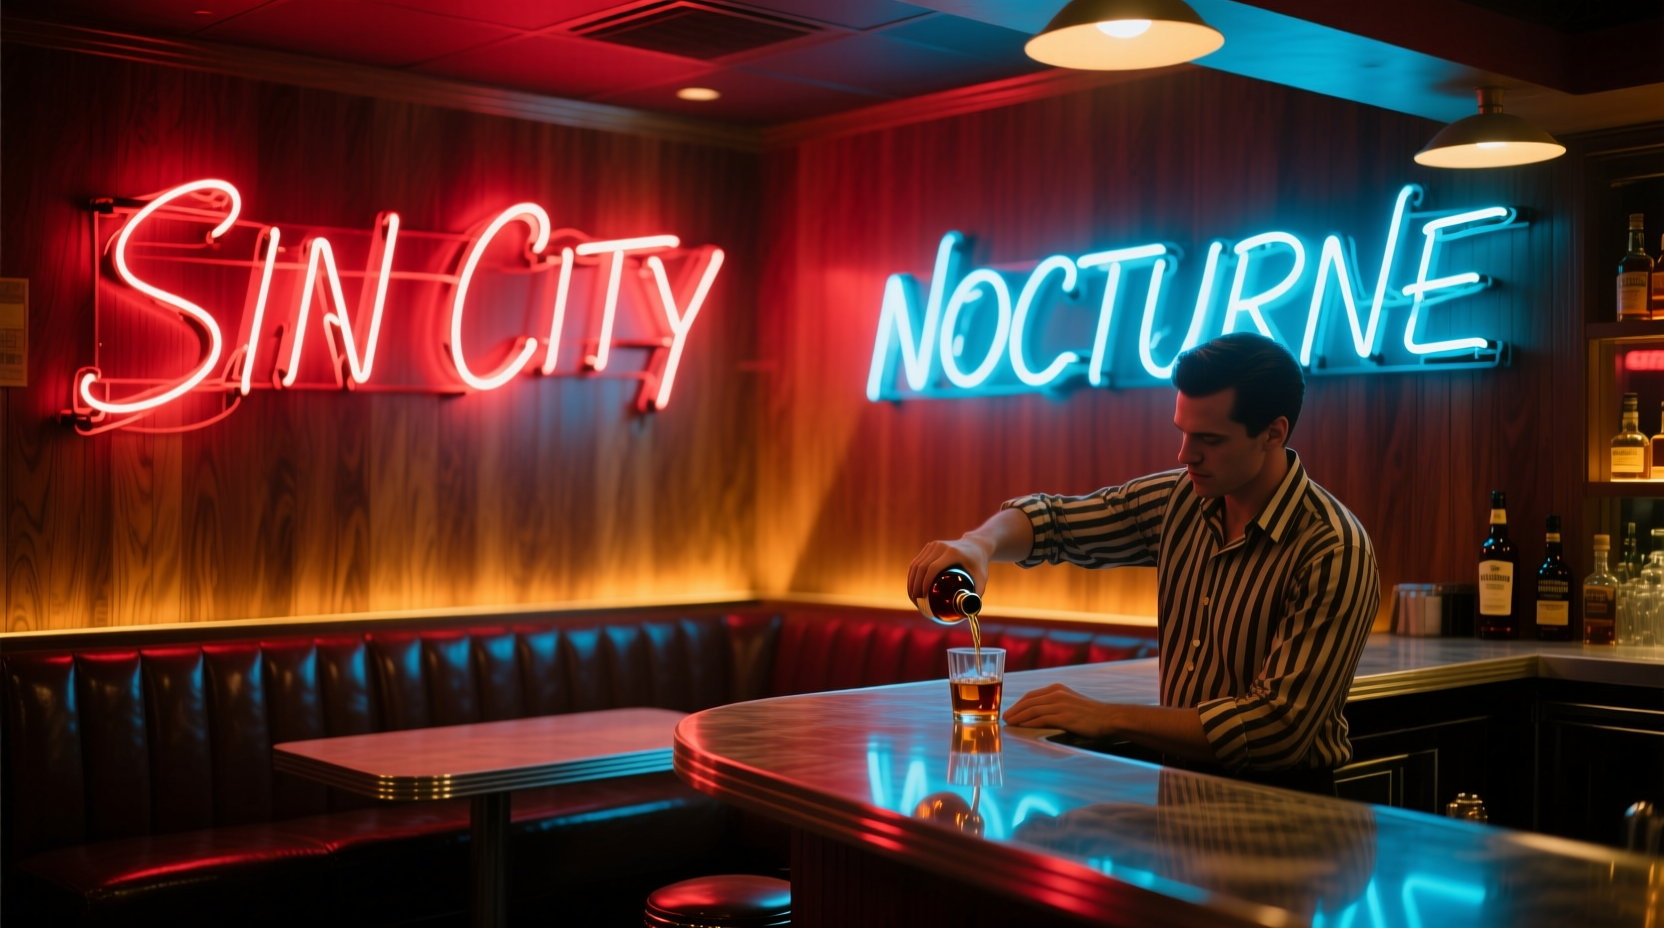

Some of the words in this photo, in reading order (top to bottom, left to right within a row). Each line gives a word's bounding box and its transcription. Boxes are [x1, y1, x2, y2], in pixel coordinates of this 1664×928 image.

[80, 178, 400, 413] SIN
[450, 202, 725, 410] CITY
[866, 183, 1508, 400] NOCTURNE
